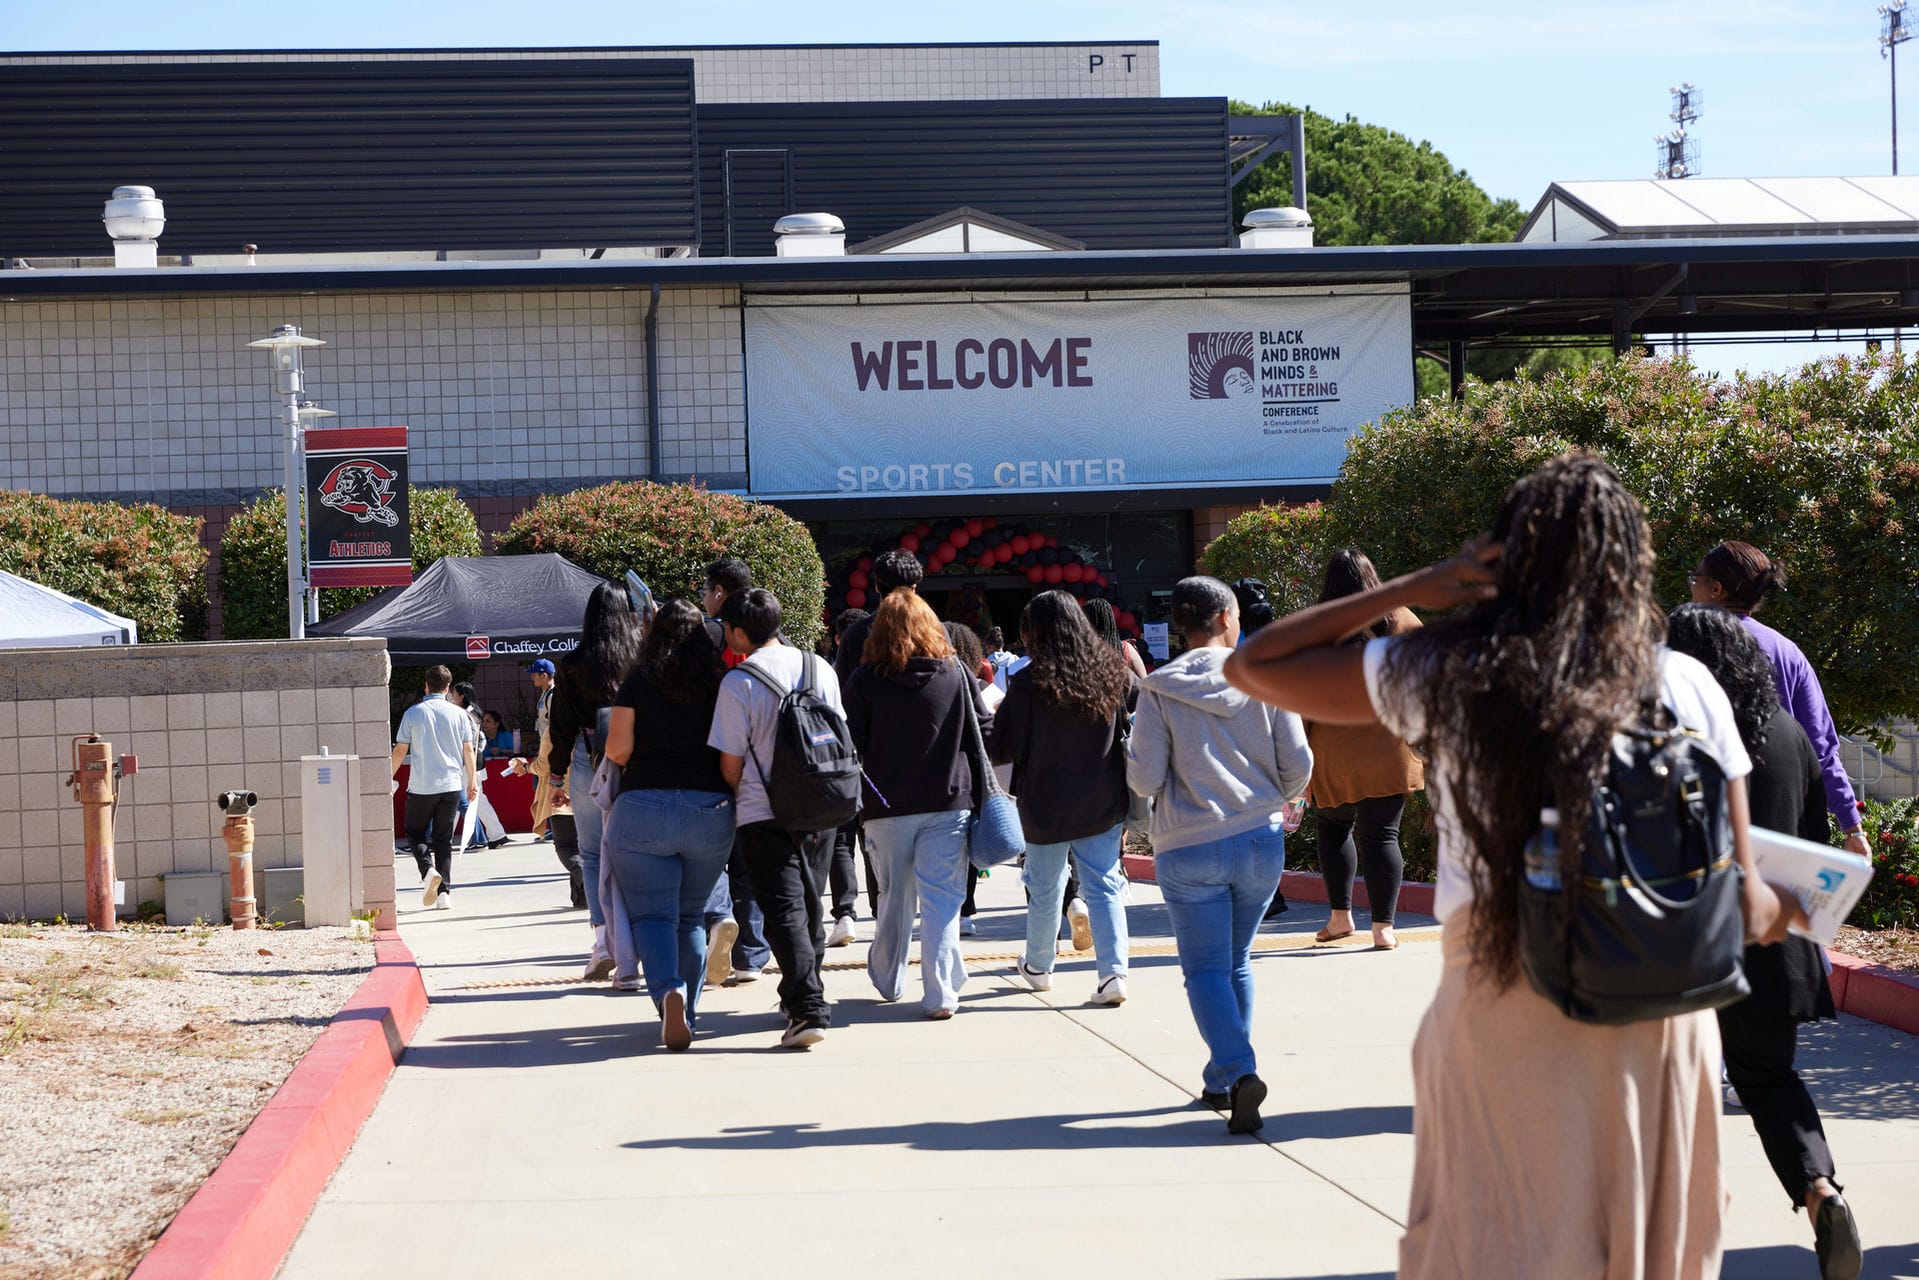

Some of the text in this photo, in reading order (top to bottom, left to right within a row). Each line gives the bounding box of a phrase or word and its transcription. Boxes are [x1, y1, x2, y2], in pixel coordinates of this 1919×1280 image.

[1260, 330, 1304, 345] BLACK
[1261, 346, 1340, 363] AND BROWN
[850, 337, 1093, 391] WELCOME
[1261, 364, 1318, 380] MINDS &
[1262, 382, 1338, 398] MATTERING
[1262, 406, 1319, 417] CONFERENCE
[1269, 419, 1311, 427] Celebration
[1298, 426, 1321, 434] Latino
[837, 458, 1127, 492] SPORTS CENTER
[493, 640, 545, 655] Chaffey
